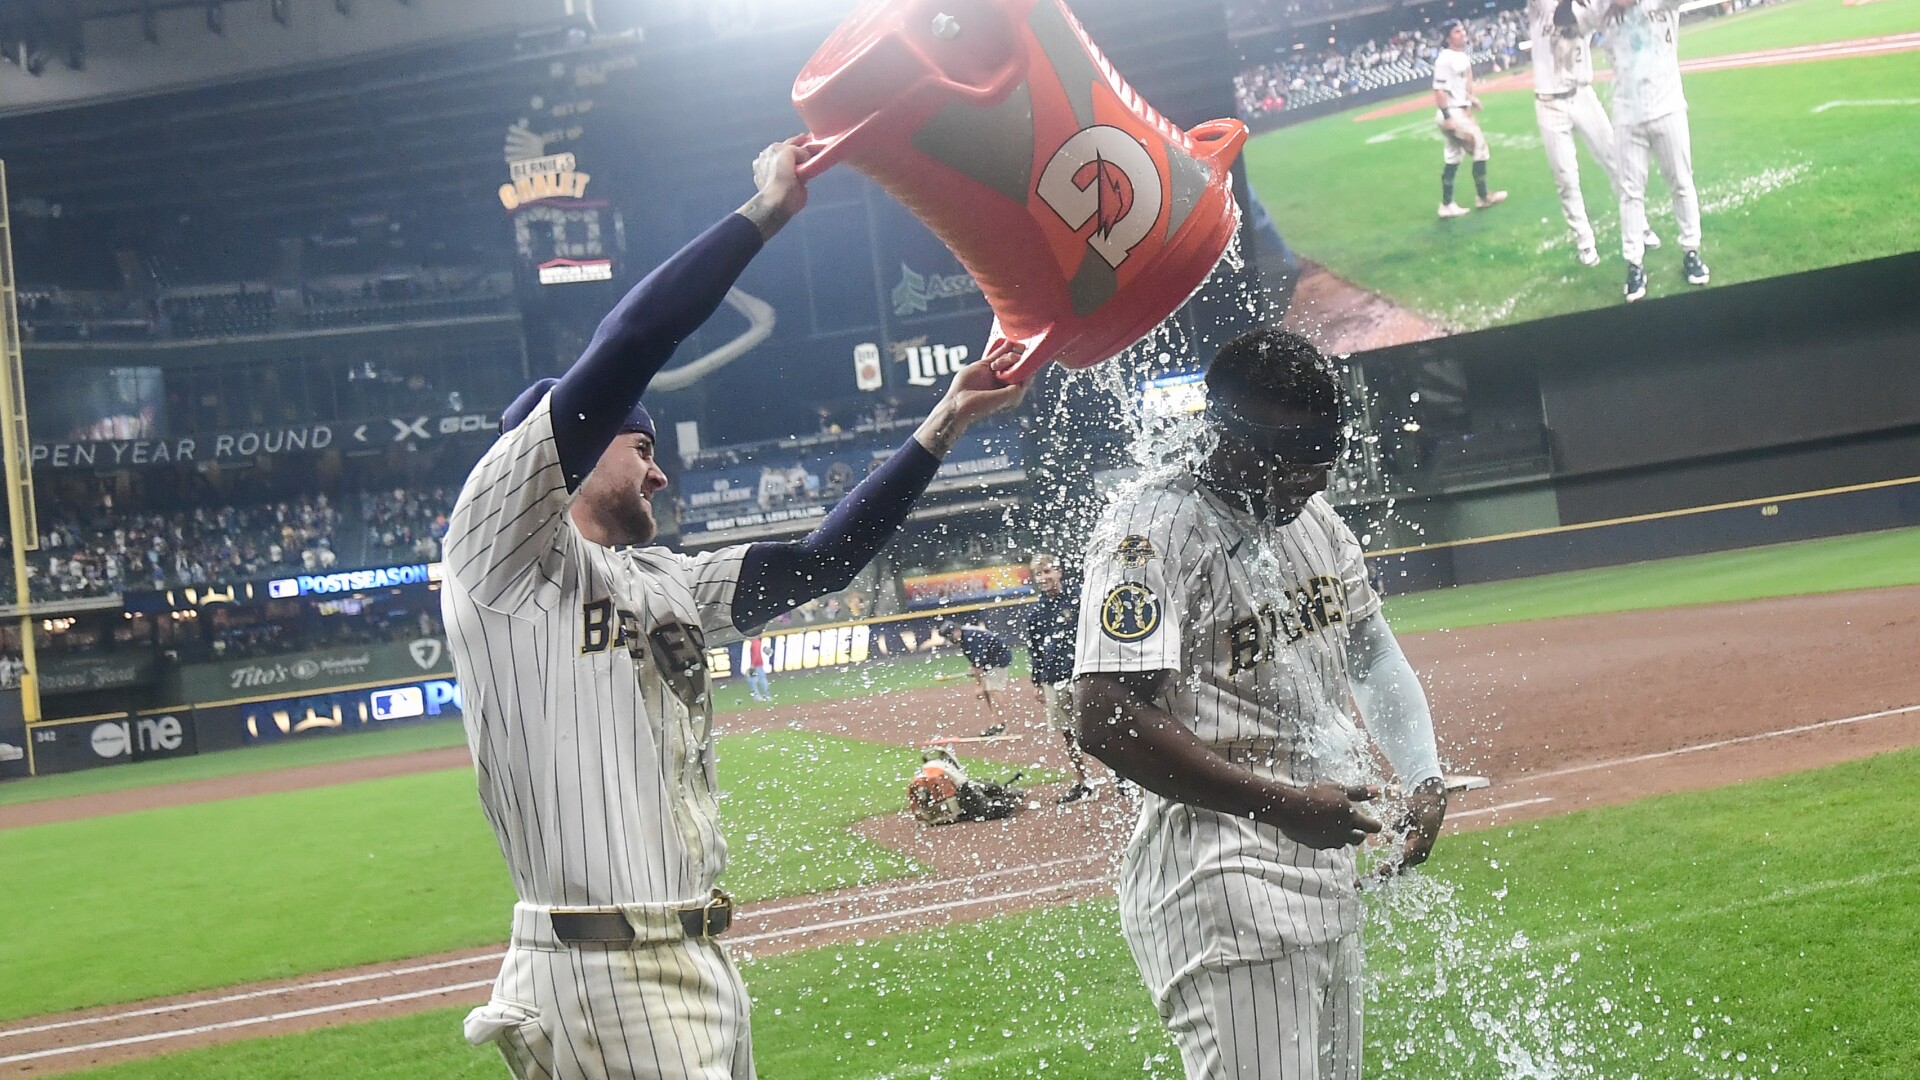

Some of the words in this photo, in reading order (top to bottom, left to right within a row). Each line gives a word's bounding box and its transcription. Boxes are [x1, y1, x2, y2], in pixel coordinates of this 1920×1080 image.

[498, 171, 591, 210] CHALET
[905, 343, 969, 387] Lite
[111, 438, 196, 465] YEAR
[215, 425, 333, 457] ROUND
[298, 563, 429, 596] POSTSEASON
[229, 663, 289, 689] Tito's
